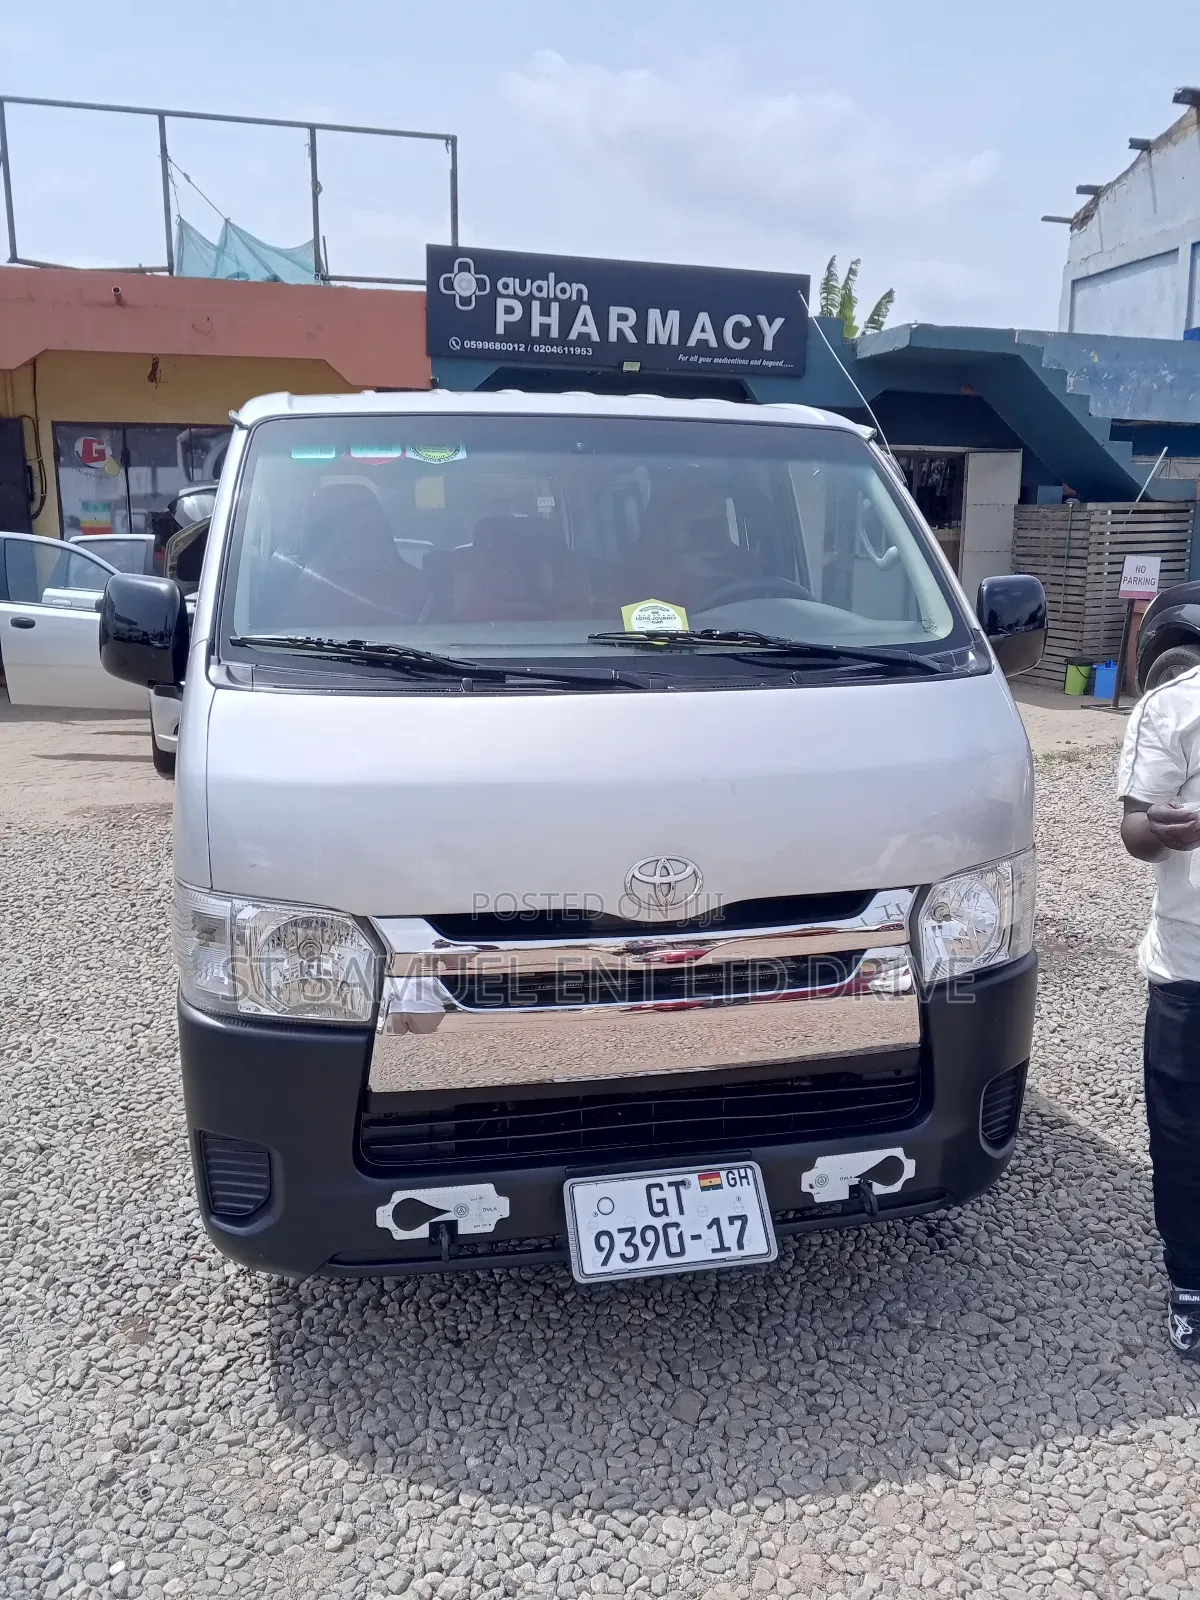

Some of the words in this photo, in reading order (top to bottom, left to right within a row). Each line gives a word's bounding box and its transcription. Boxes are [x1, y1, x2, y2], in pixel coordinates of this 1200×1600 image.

[495, 297, 786, 351] PHARMACY
[463, 340, 526, 352] 0599680012
[533, 344, 593, 356] 0204611953
[678, 353, 689, 362] For
[698, 356, 713, 364] your
[713, 356, 749, 365] medications
[1135, 565, 1147, 574] NO
[1122, 576, 1156, 586] PARKING
[645, 1180, 687, 1218] GT
[726, 1168, 750, 1188] GH
[594, 1214, 749, 1267] 9390-17
